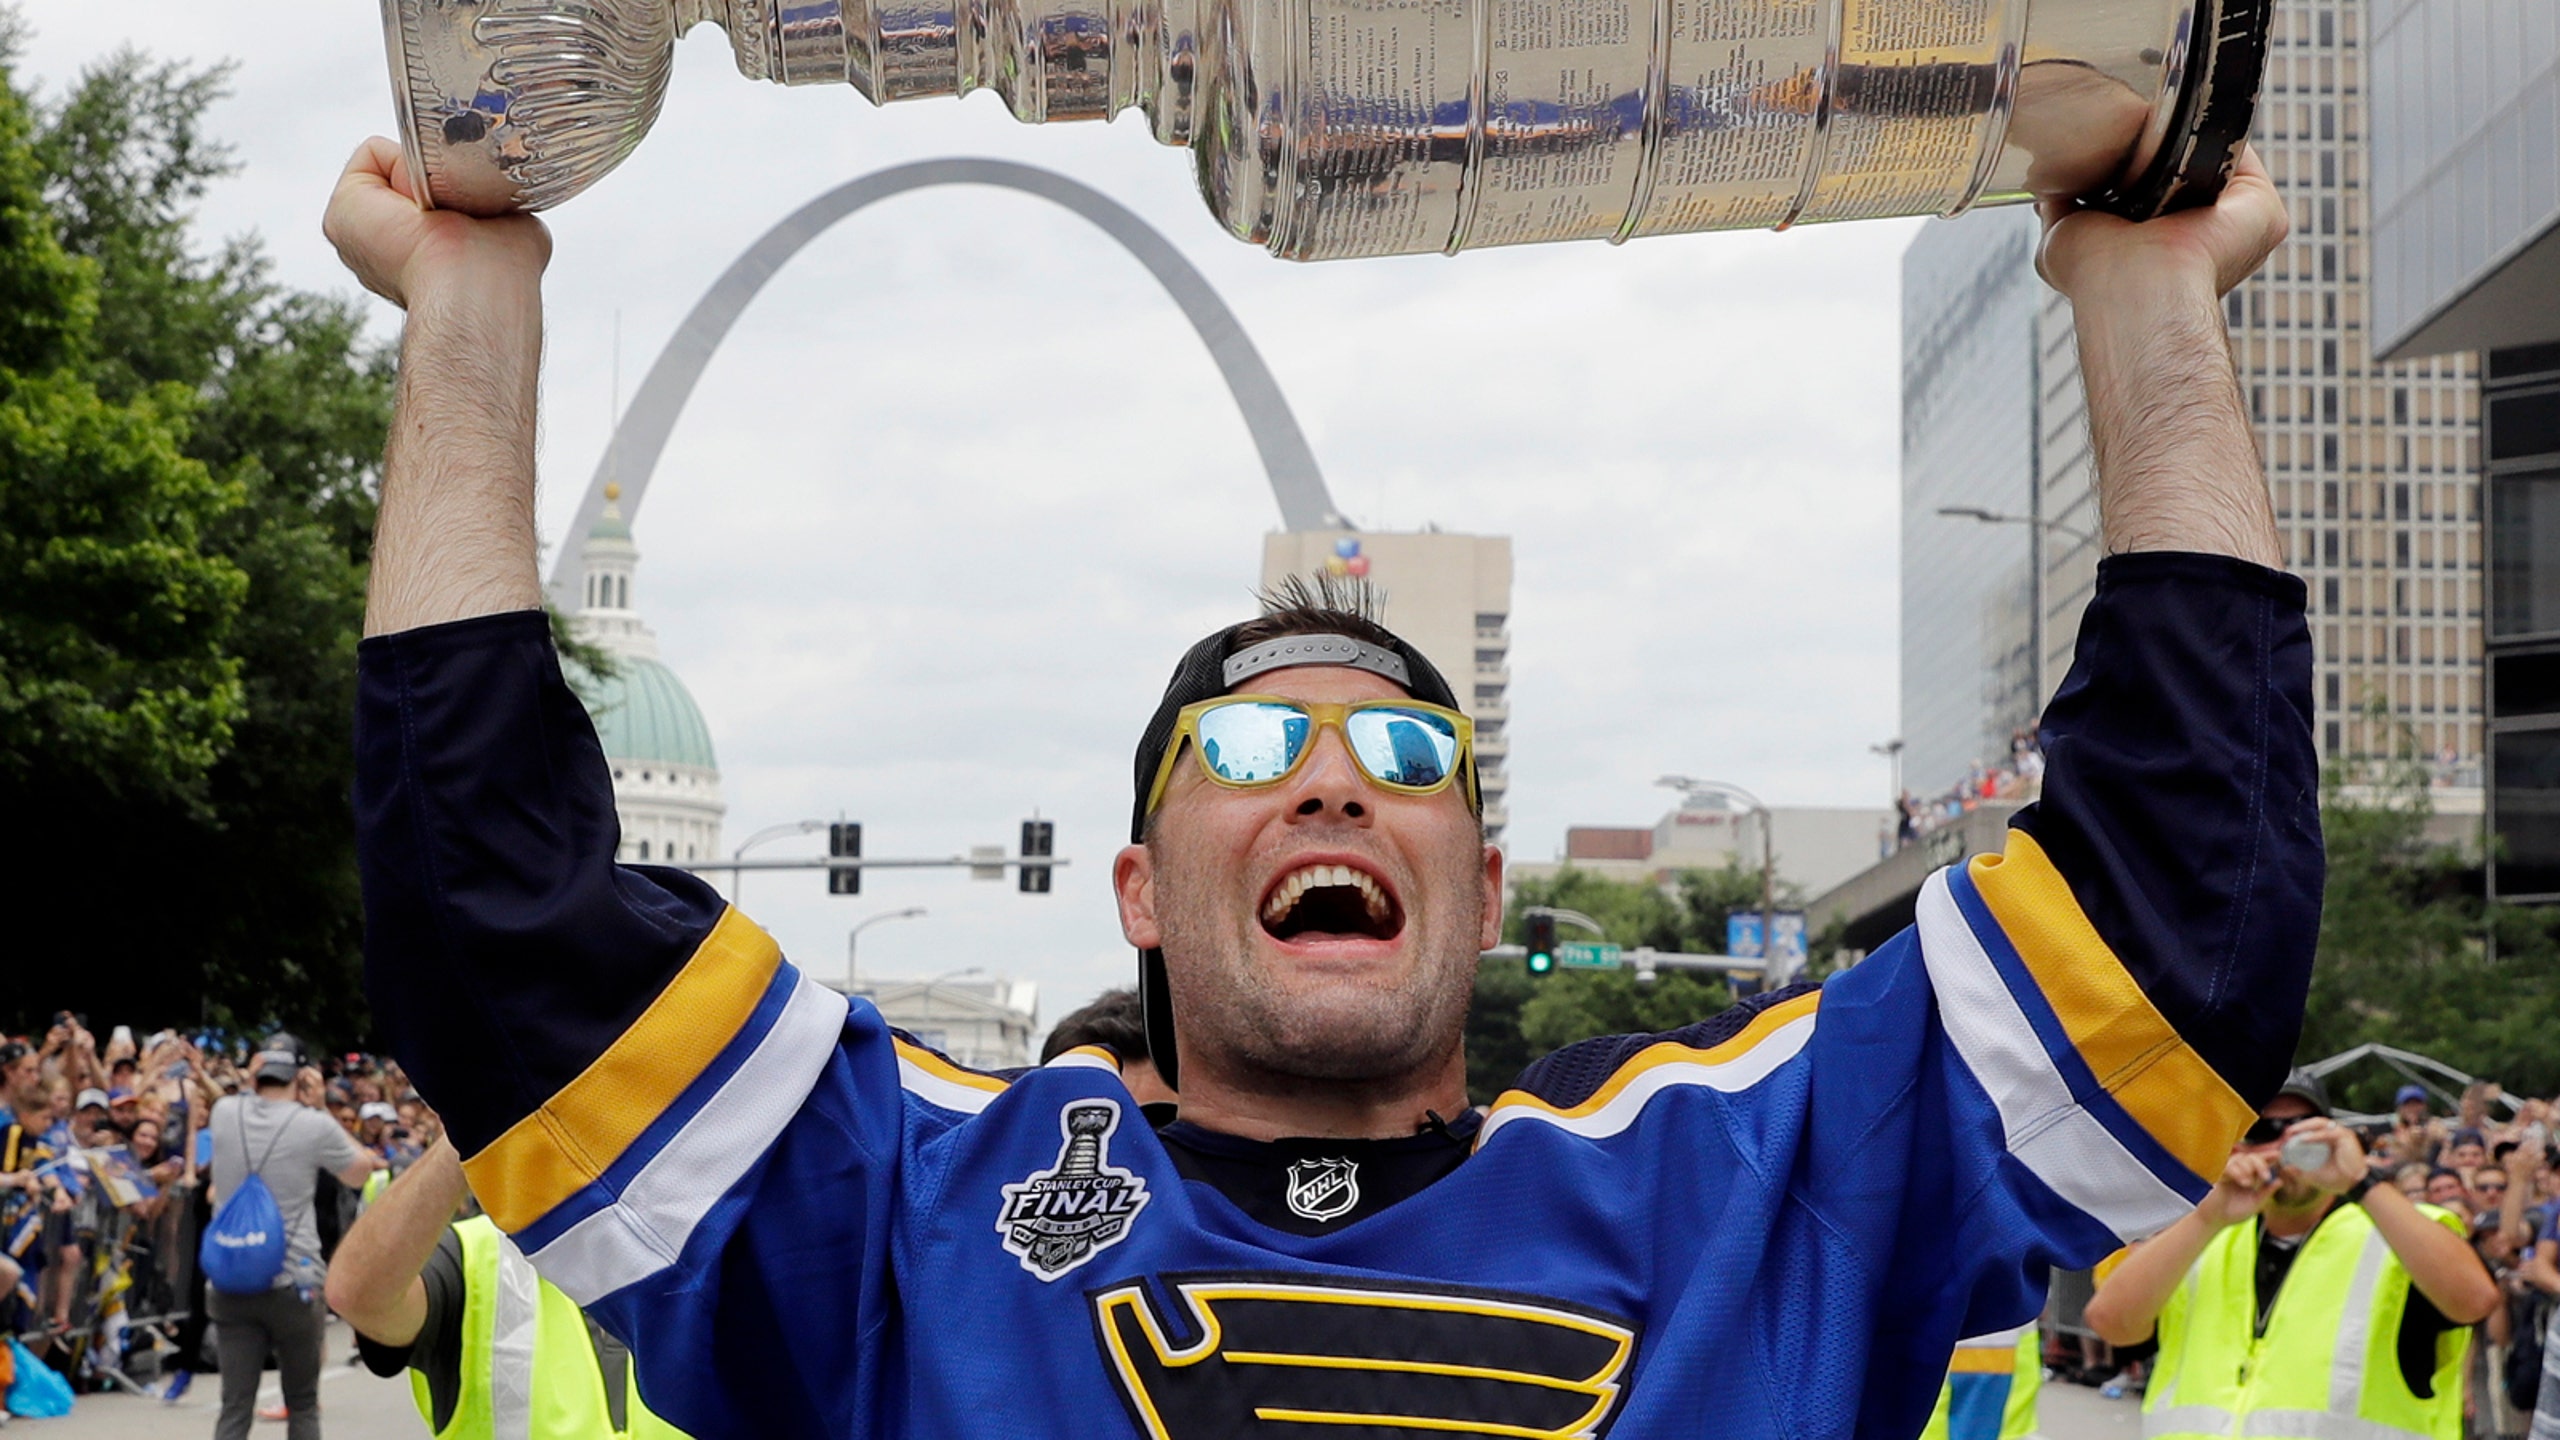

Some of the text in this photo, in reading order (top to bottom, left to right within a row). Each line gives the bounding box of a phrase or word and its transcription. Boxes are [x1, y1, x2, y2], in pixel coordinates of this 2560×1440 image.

[1031, 1177, 1122, 1193] STANLEY CUP
[1303, 1172, 1343, 1206] NHL
[1010, 1189, 1131, 1218] FINAL
